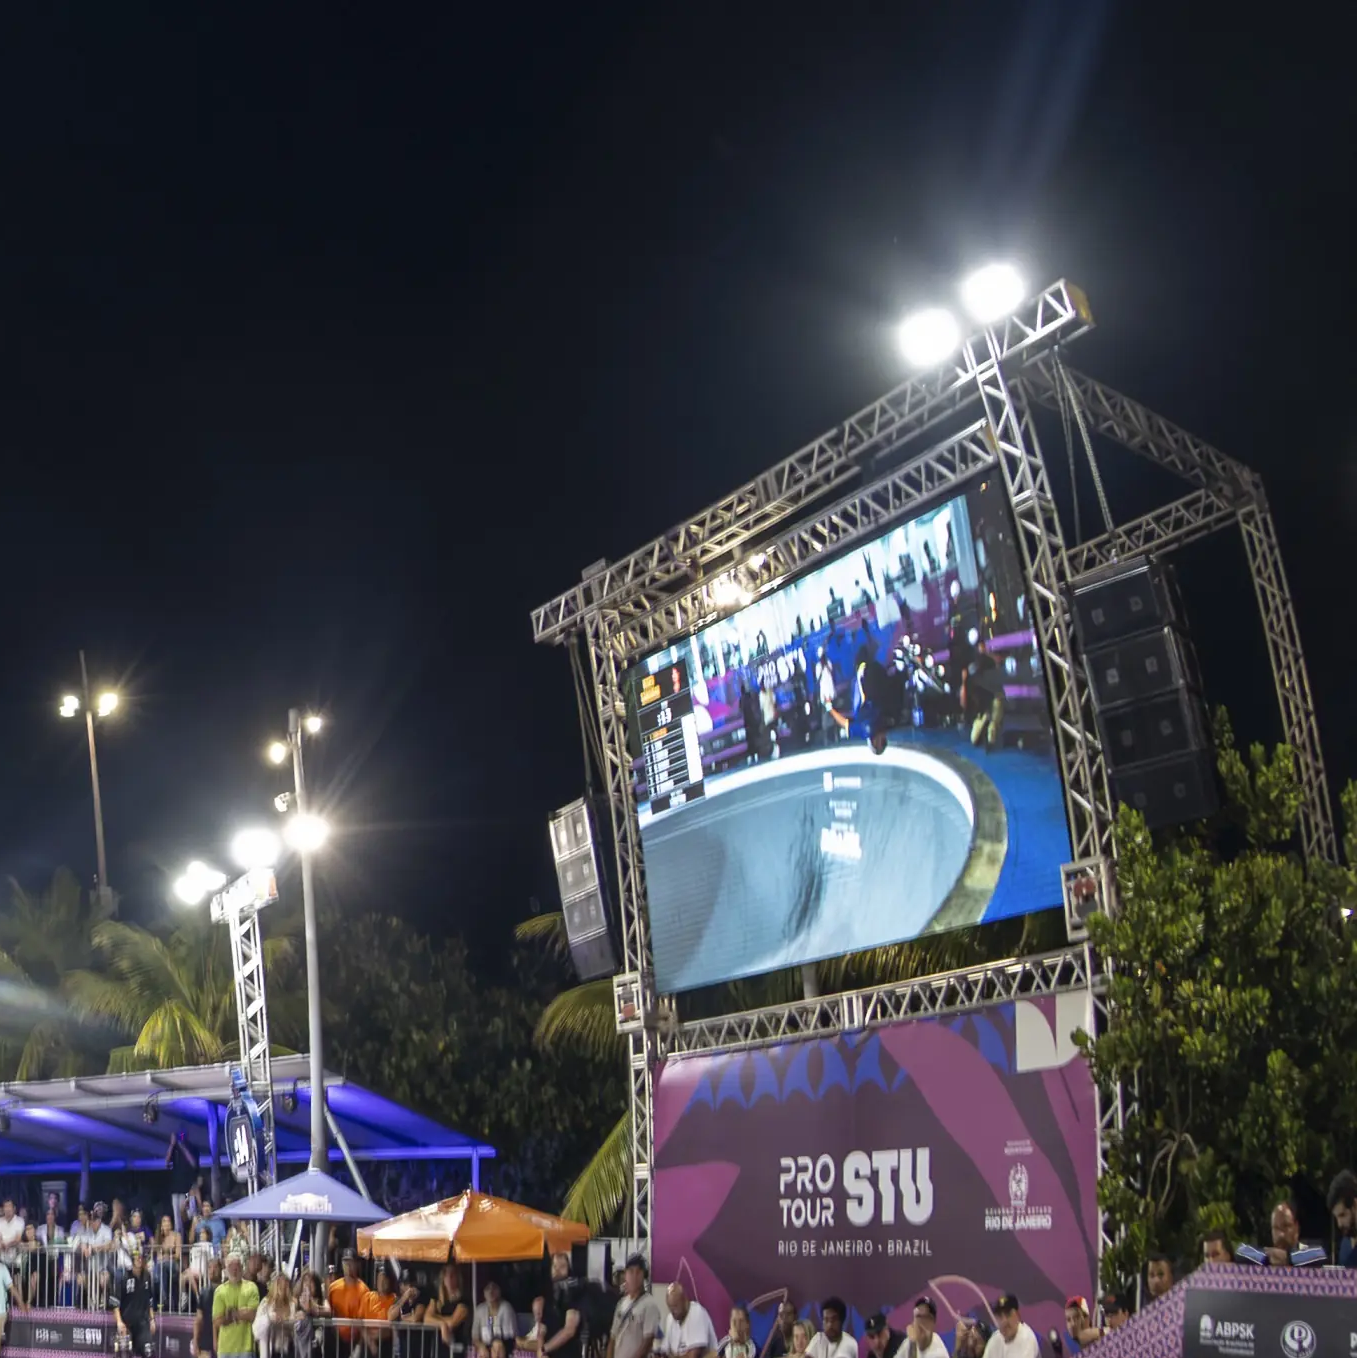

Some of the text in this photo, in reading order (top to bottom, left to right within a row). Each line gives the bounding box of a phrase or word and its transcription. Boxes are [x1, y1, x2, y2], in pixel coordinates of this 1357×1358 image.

[779, 1153, 836, 1194] PRO
[843, 1147, 934, 1227] STU
[779, 1197, 835, 1229] TOUR
[985, 1214, 1052, 1231] RIO DE JANEIRO
[778, 1239, 933, 1257] RIO DE JANEIRO BRAZIL
[1215, 1321, 1255, 1339] ABPSK
